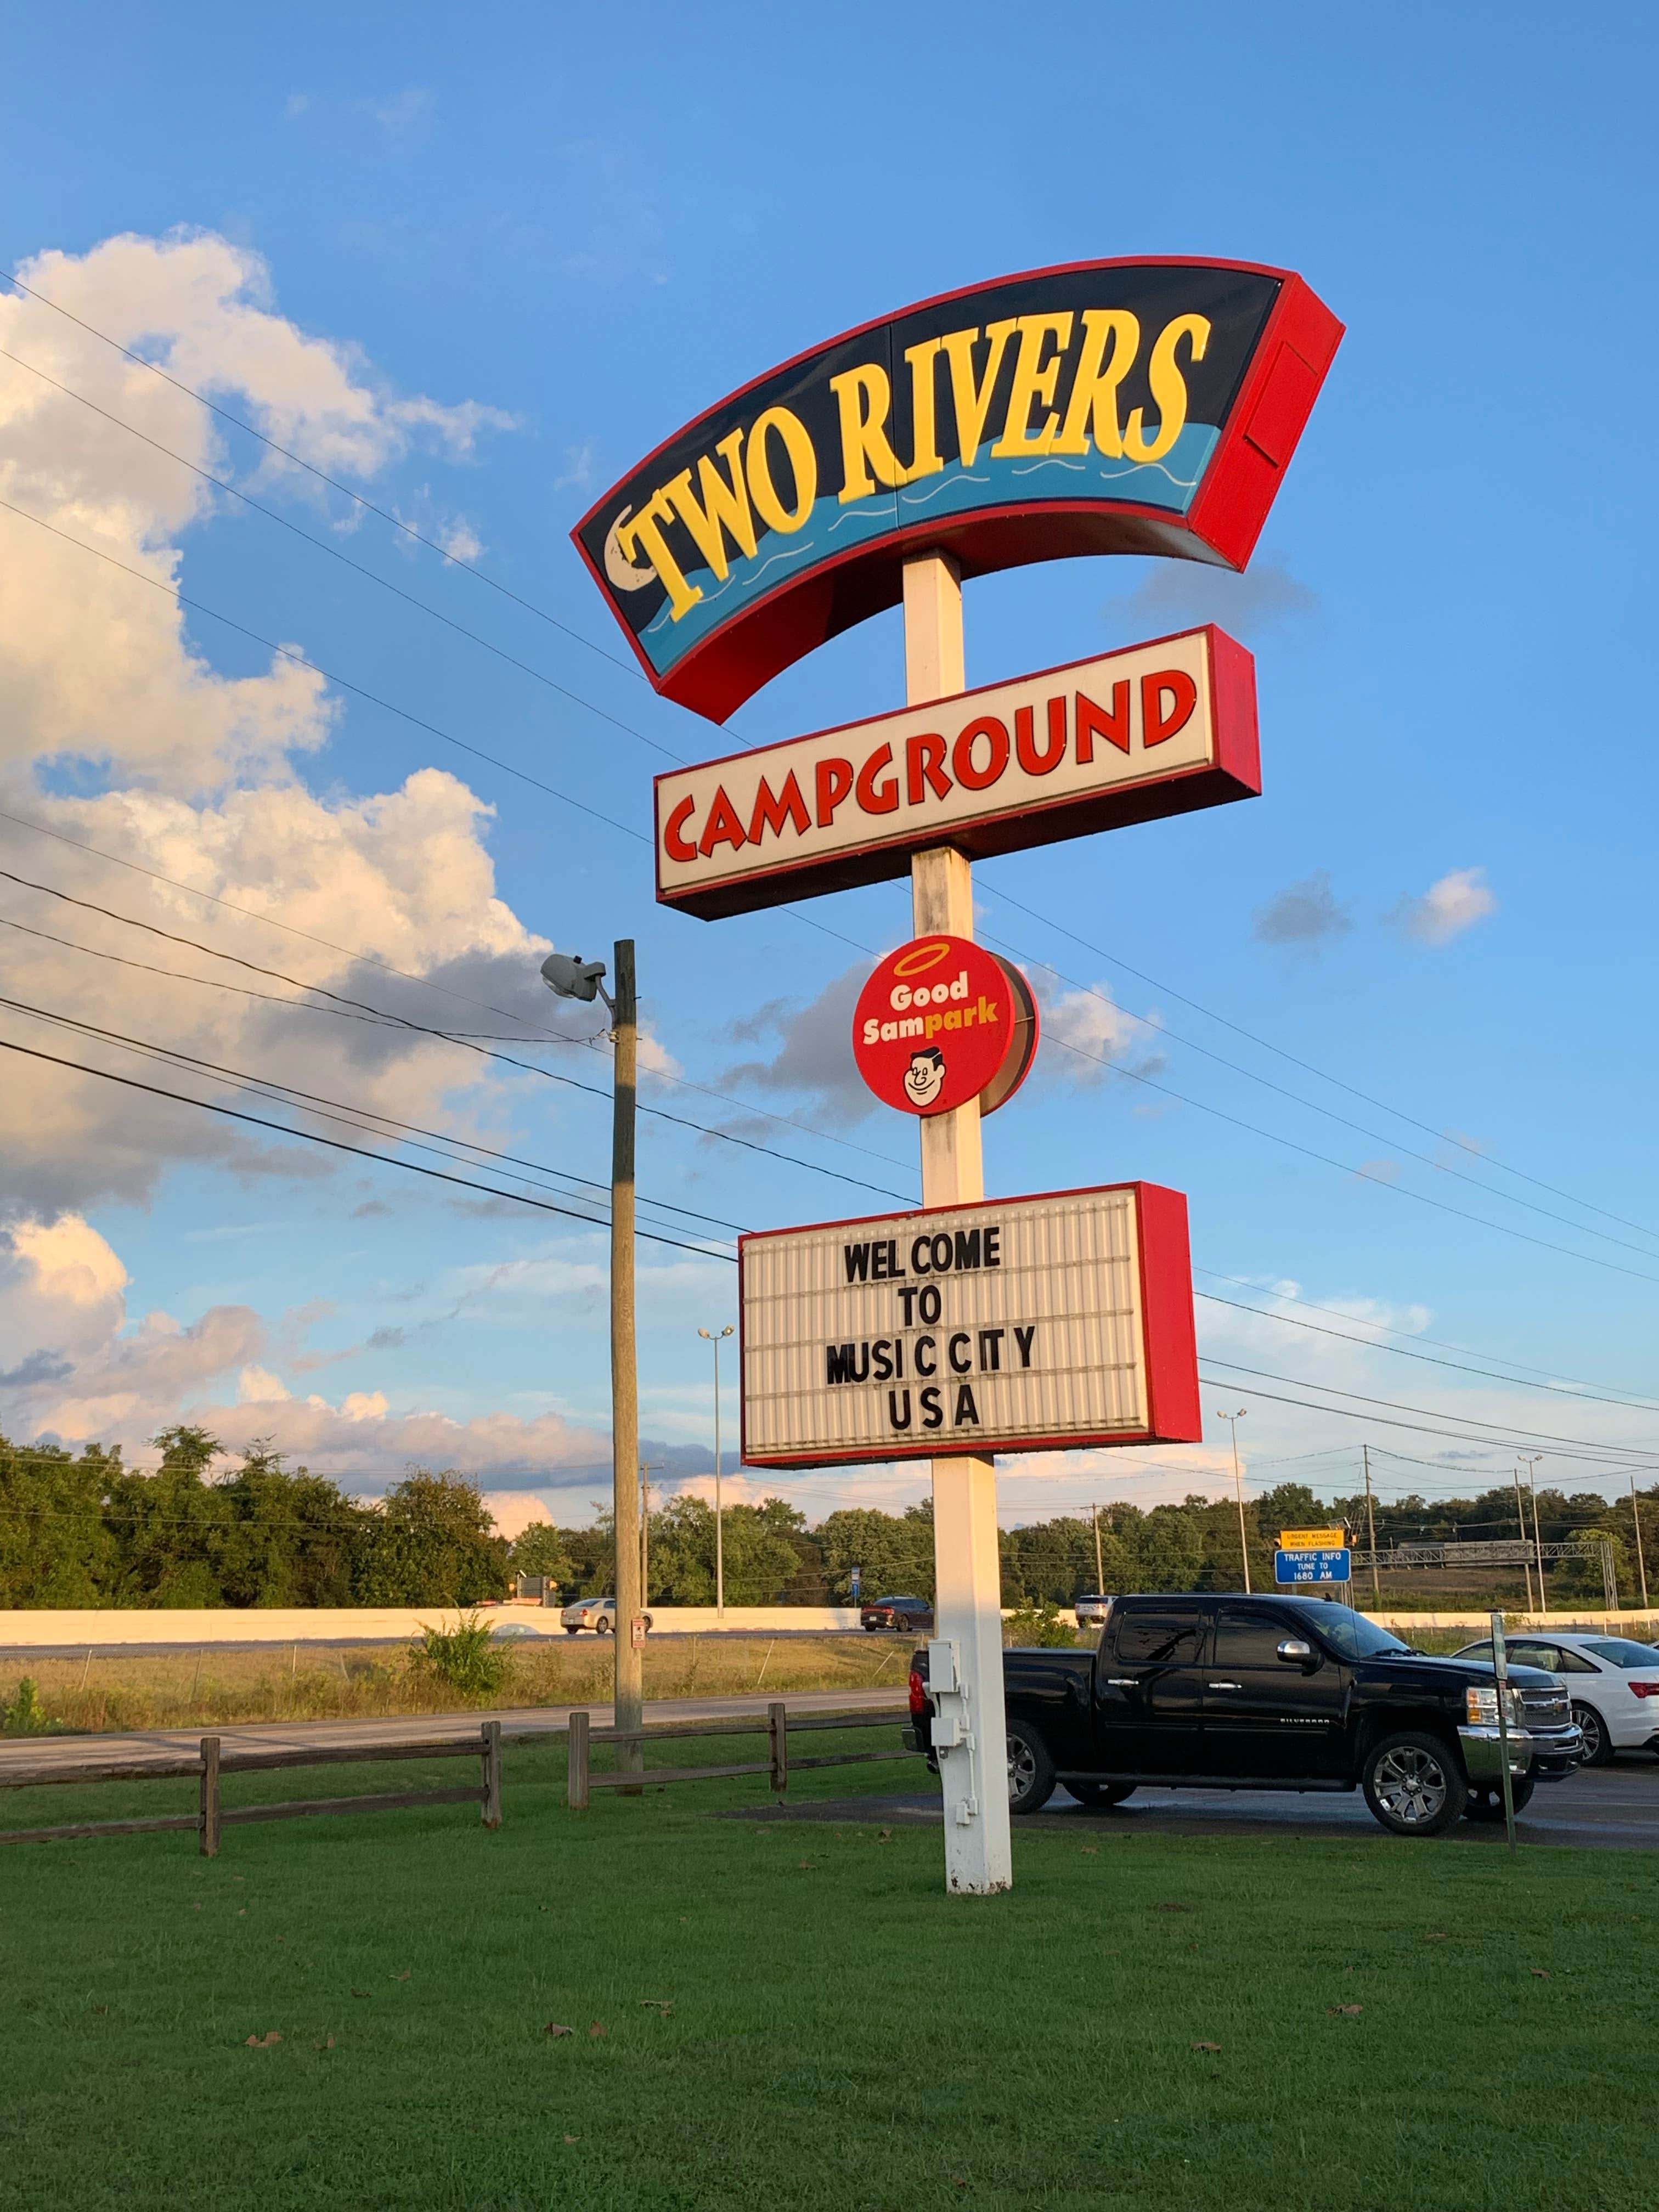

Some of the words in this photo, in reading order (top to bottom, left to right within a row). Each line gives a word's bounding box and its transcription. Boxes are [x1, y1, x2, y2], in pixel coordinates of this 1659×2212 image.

[616, 407, 817, 622] TWO
[829, 309, 1211, 505] RIVERS
[664, 669, 1198, 863] CAMPGROUND
[890, 970, 969, 1011] Good
[863, 996, 999, 1045] Sampark
[844, 1226, 1000, 1283] WELCOME
[898, 1285, 942, 1327] TO
[826, 1335, 937, 1385] MUSIC
[949, 1325, 1036, 1373] CITY
[889, 1384, 980, 1430] USA
[1284, 1553, 1317, 1562] TRAFFIC
[1322, 1552, 1341, 1560] INFO
[1294, 1572, 1313, 1580] 1680
[1320, 1571, 1333, 1579] AM
